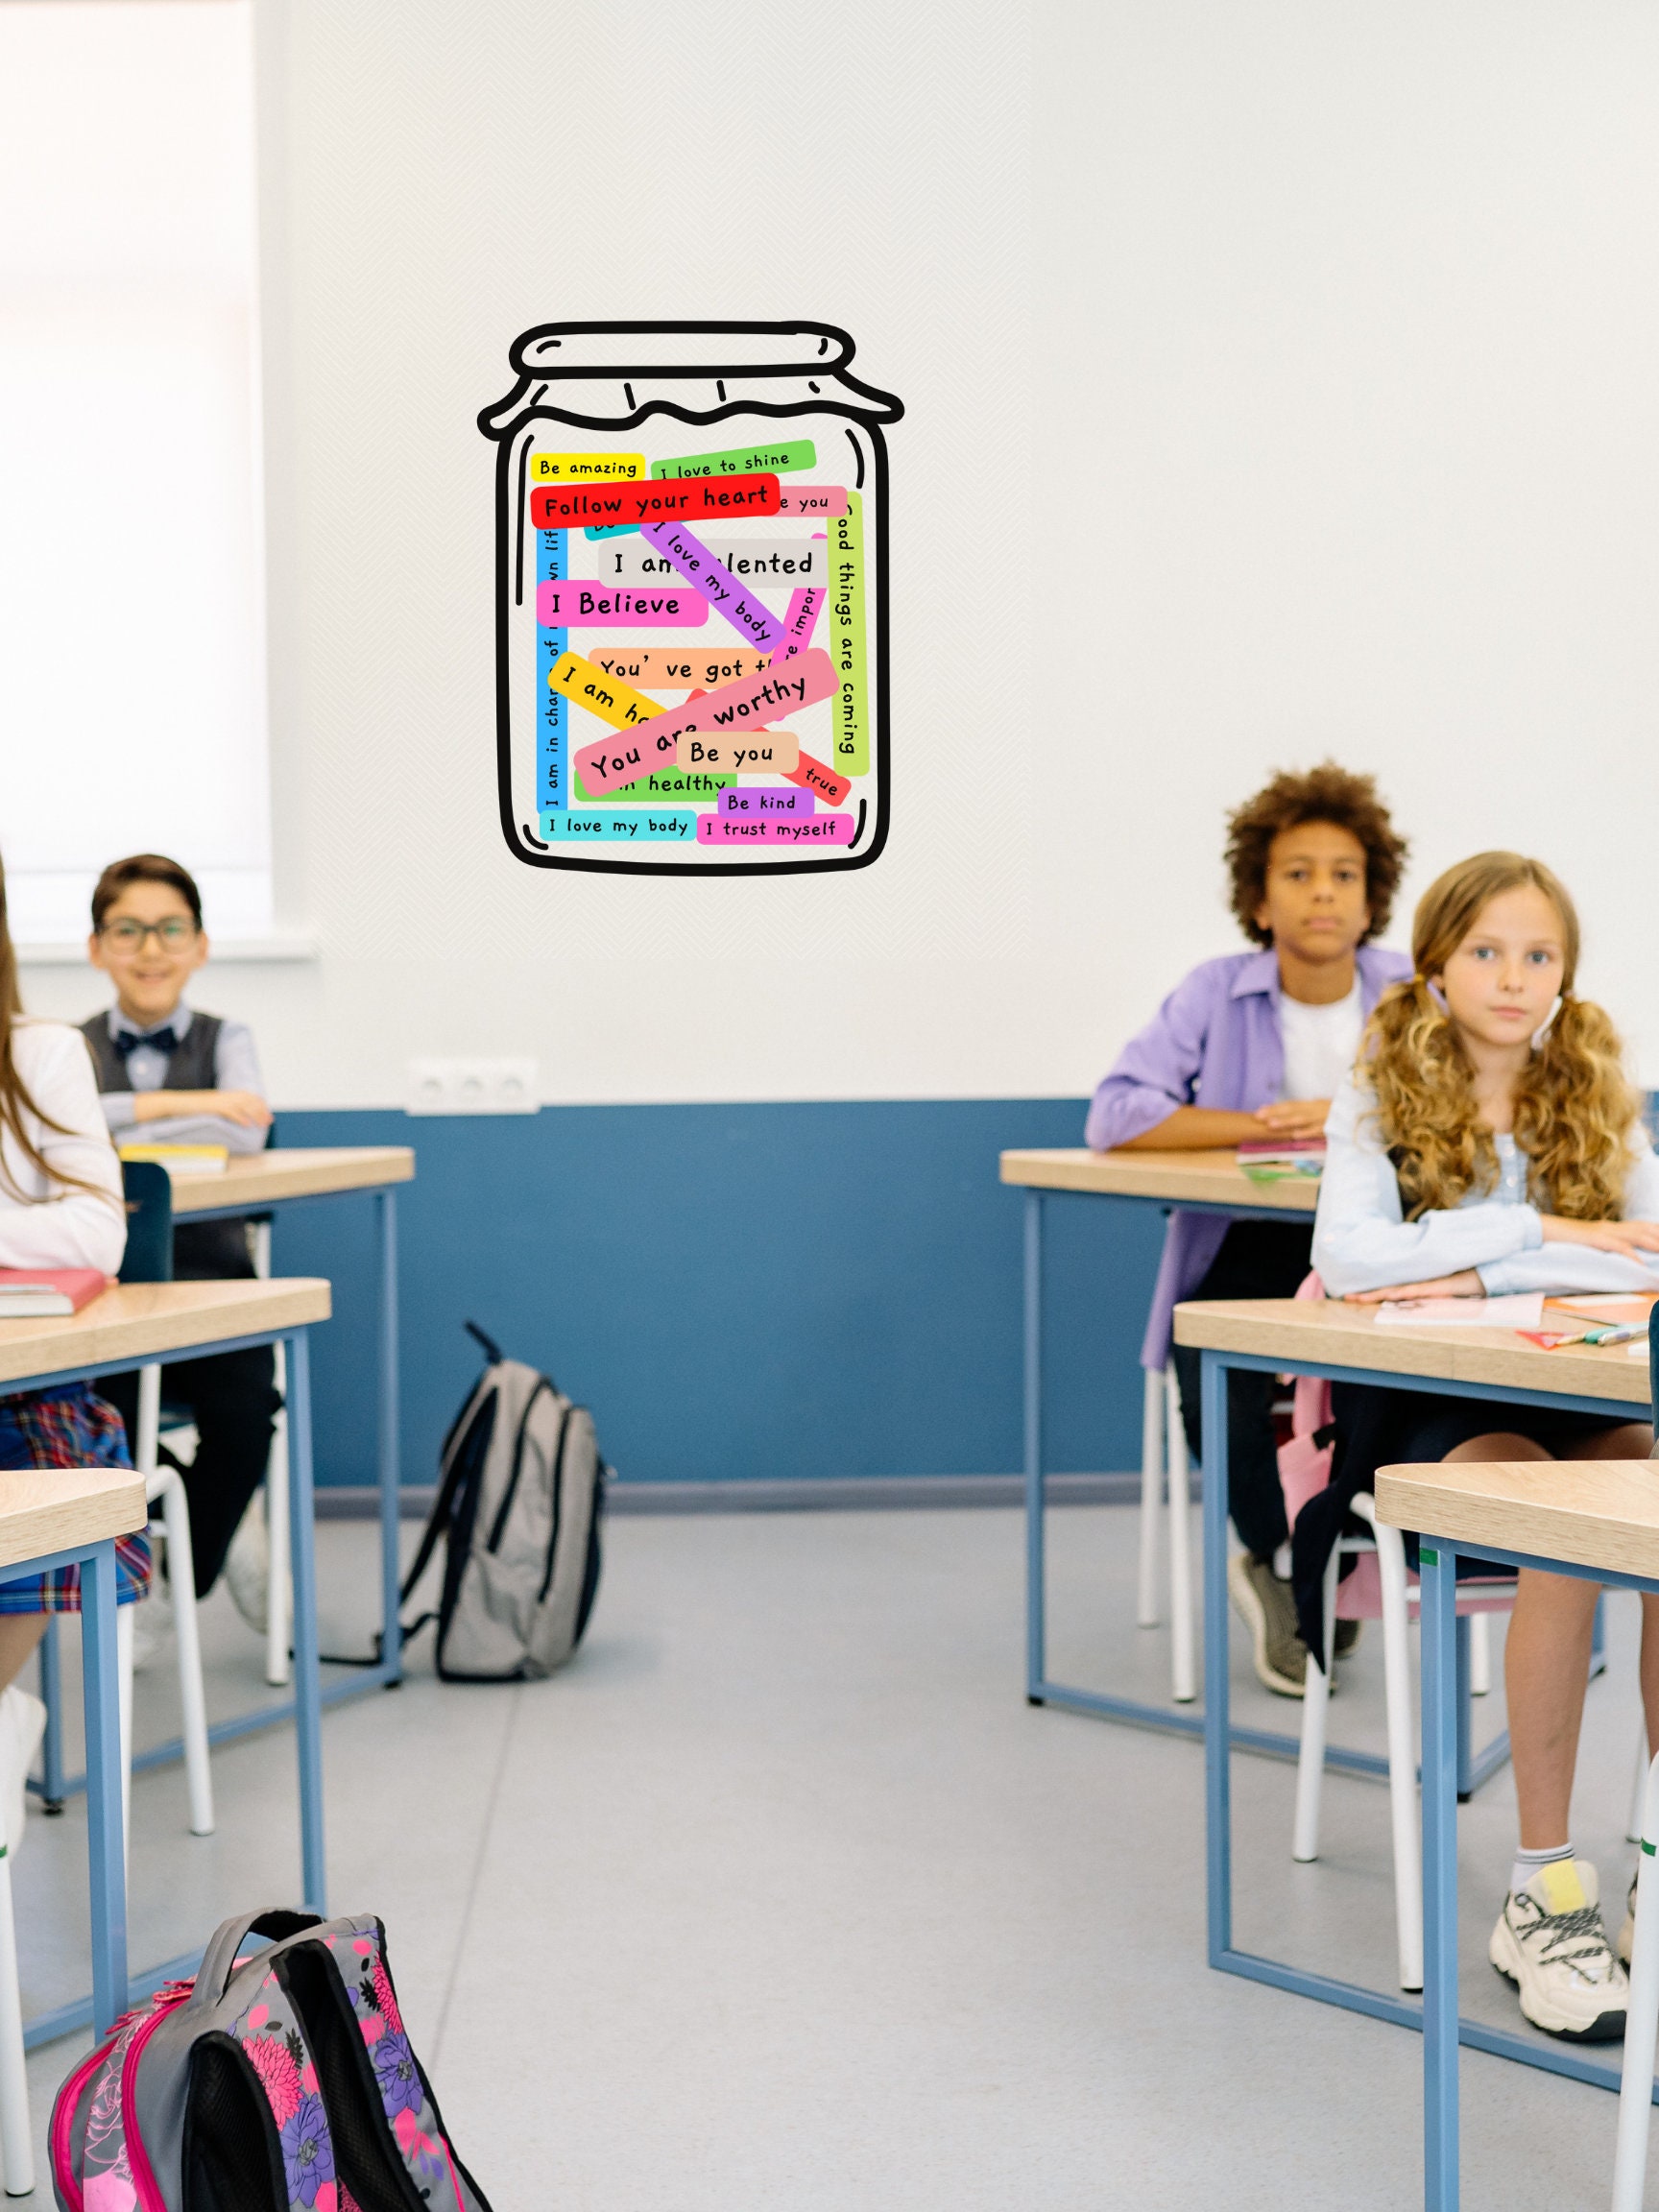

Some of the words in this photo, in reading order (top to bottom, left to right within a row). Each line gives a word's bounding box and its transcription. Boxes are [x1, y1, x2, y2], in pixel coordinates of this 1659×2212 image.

[541, 461, 560, 474] Be
[569, 462, 637, 478] amazing
[661, 469, 667, 480] I
[678, 466, 711, 479] love
[720, 460, 736, 471] to
[745, 454, 789, 469] shine
[545, 495, 622, 517] Follow
[636, 495, 688, 517] your
[704, 486, 768, 506] heart
[799, 499, 829, 513] you
[838, 504, 854, 550] ood
[543, 530, 559, 551] lif
[548, 562, 559, 581] wn
[614, 553, 623, 573] I
[717, 552, 812, 574] lented
[653, 521, 666, 533] I
[667, 535, 700, 571] love
[705, 574, 730, 601] my
[734, 600, 771, 641] body
[552, 593, 561, 613] I
[580, 591, 680, 614] Believe
[835, 562, 854, 626] things
[790, 588, 816, 635] impor
[543, 640, 559, 657] of
[841, 638, 853, 671] are
[705, 660, 743, 684] got
[563, 666, 577, 683] I
[584, 684, 614, 708] am
[544, 687, 559, 727] char
[838, 683, 857, 754] coming
[590, 748, 641, 779] You
[713, 677, 805, 725] worthy
[545, 737, 559, 753] in
[690, 741, 719, 762] Be
[733, 748, 773, 768] you
[548, 764, 559, 789] am
[649, 774, 726, 797] healthy
[805, 768, 838, 796] true
[728, 794, 750, 810] Be
[759, 795, 796, 809] kind
[549, 818, 555, 831] I
[567, 818, 602, 832] love
[613, 822, 638, 837] my
[648, 818, 688, 837] body
[707, 822, 712, 835] I
[723, 822, 767, 836] trust
[777, 821, 836, 840] myself
